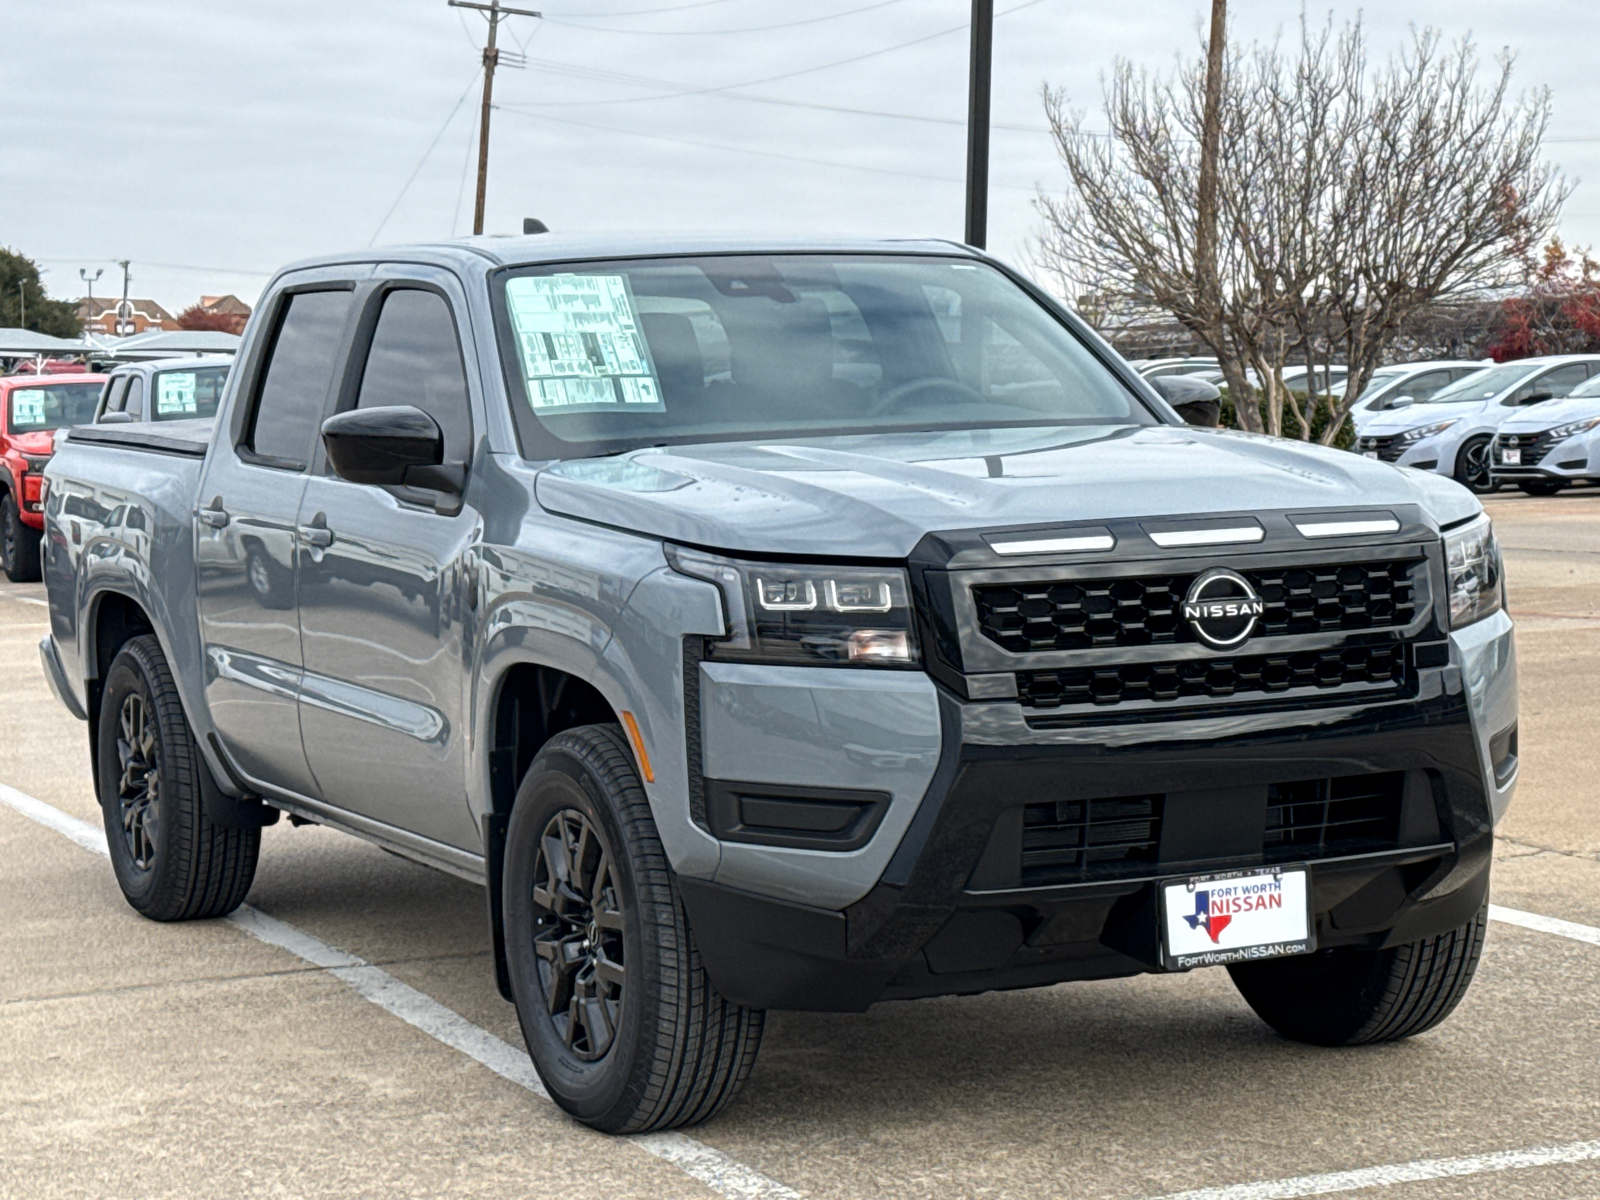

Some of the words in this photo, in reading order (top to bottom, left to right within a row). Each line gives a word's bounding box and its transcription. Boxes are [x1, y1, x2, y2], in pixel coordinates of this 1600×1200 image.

[1185, 602, 1263, 618] NISSAN
[1211, 887, 1239, 898] FORT
[1241, 882, 1281, 895] WORTH
[1211, 893, 1282, 915] NISSAN
